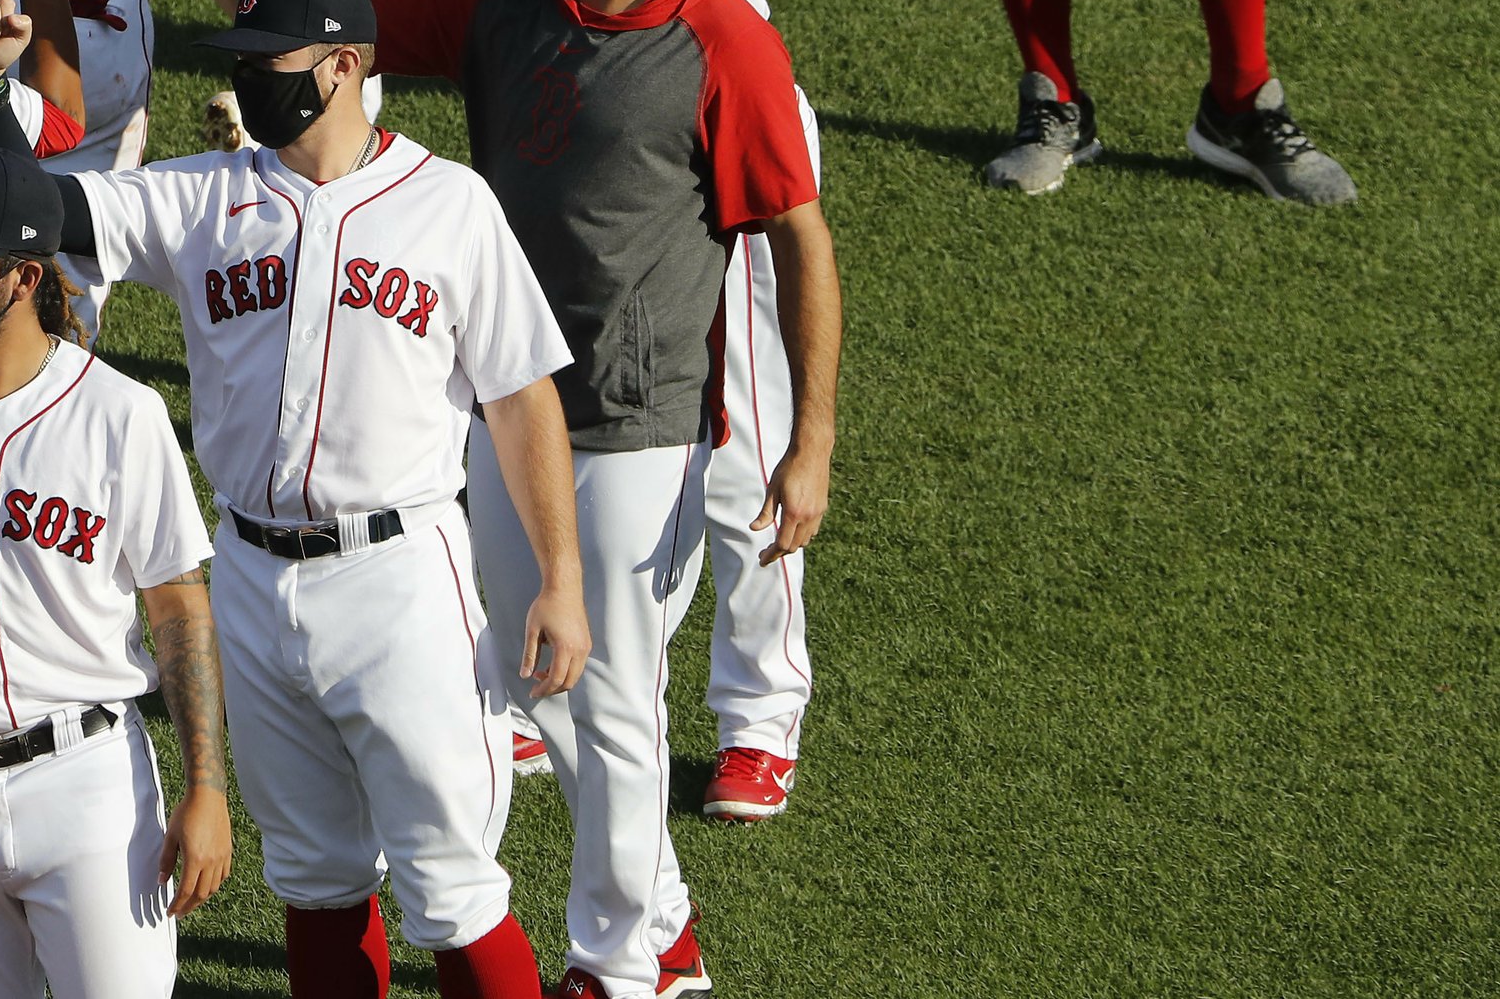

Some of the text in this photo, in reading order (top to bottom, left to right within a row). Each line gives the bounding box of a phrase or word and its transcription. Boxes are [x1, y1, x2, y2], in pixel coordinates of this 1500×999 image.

[205, 255, 439, 339] RED SOX
[2, 488, 107, 565] SOX
